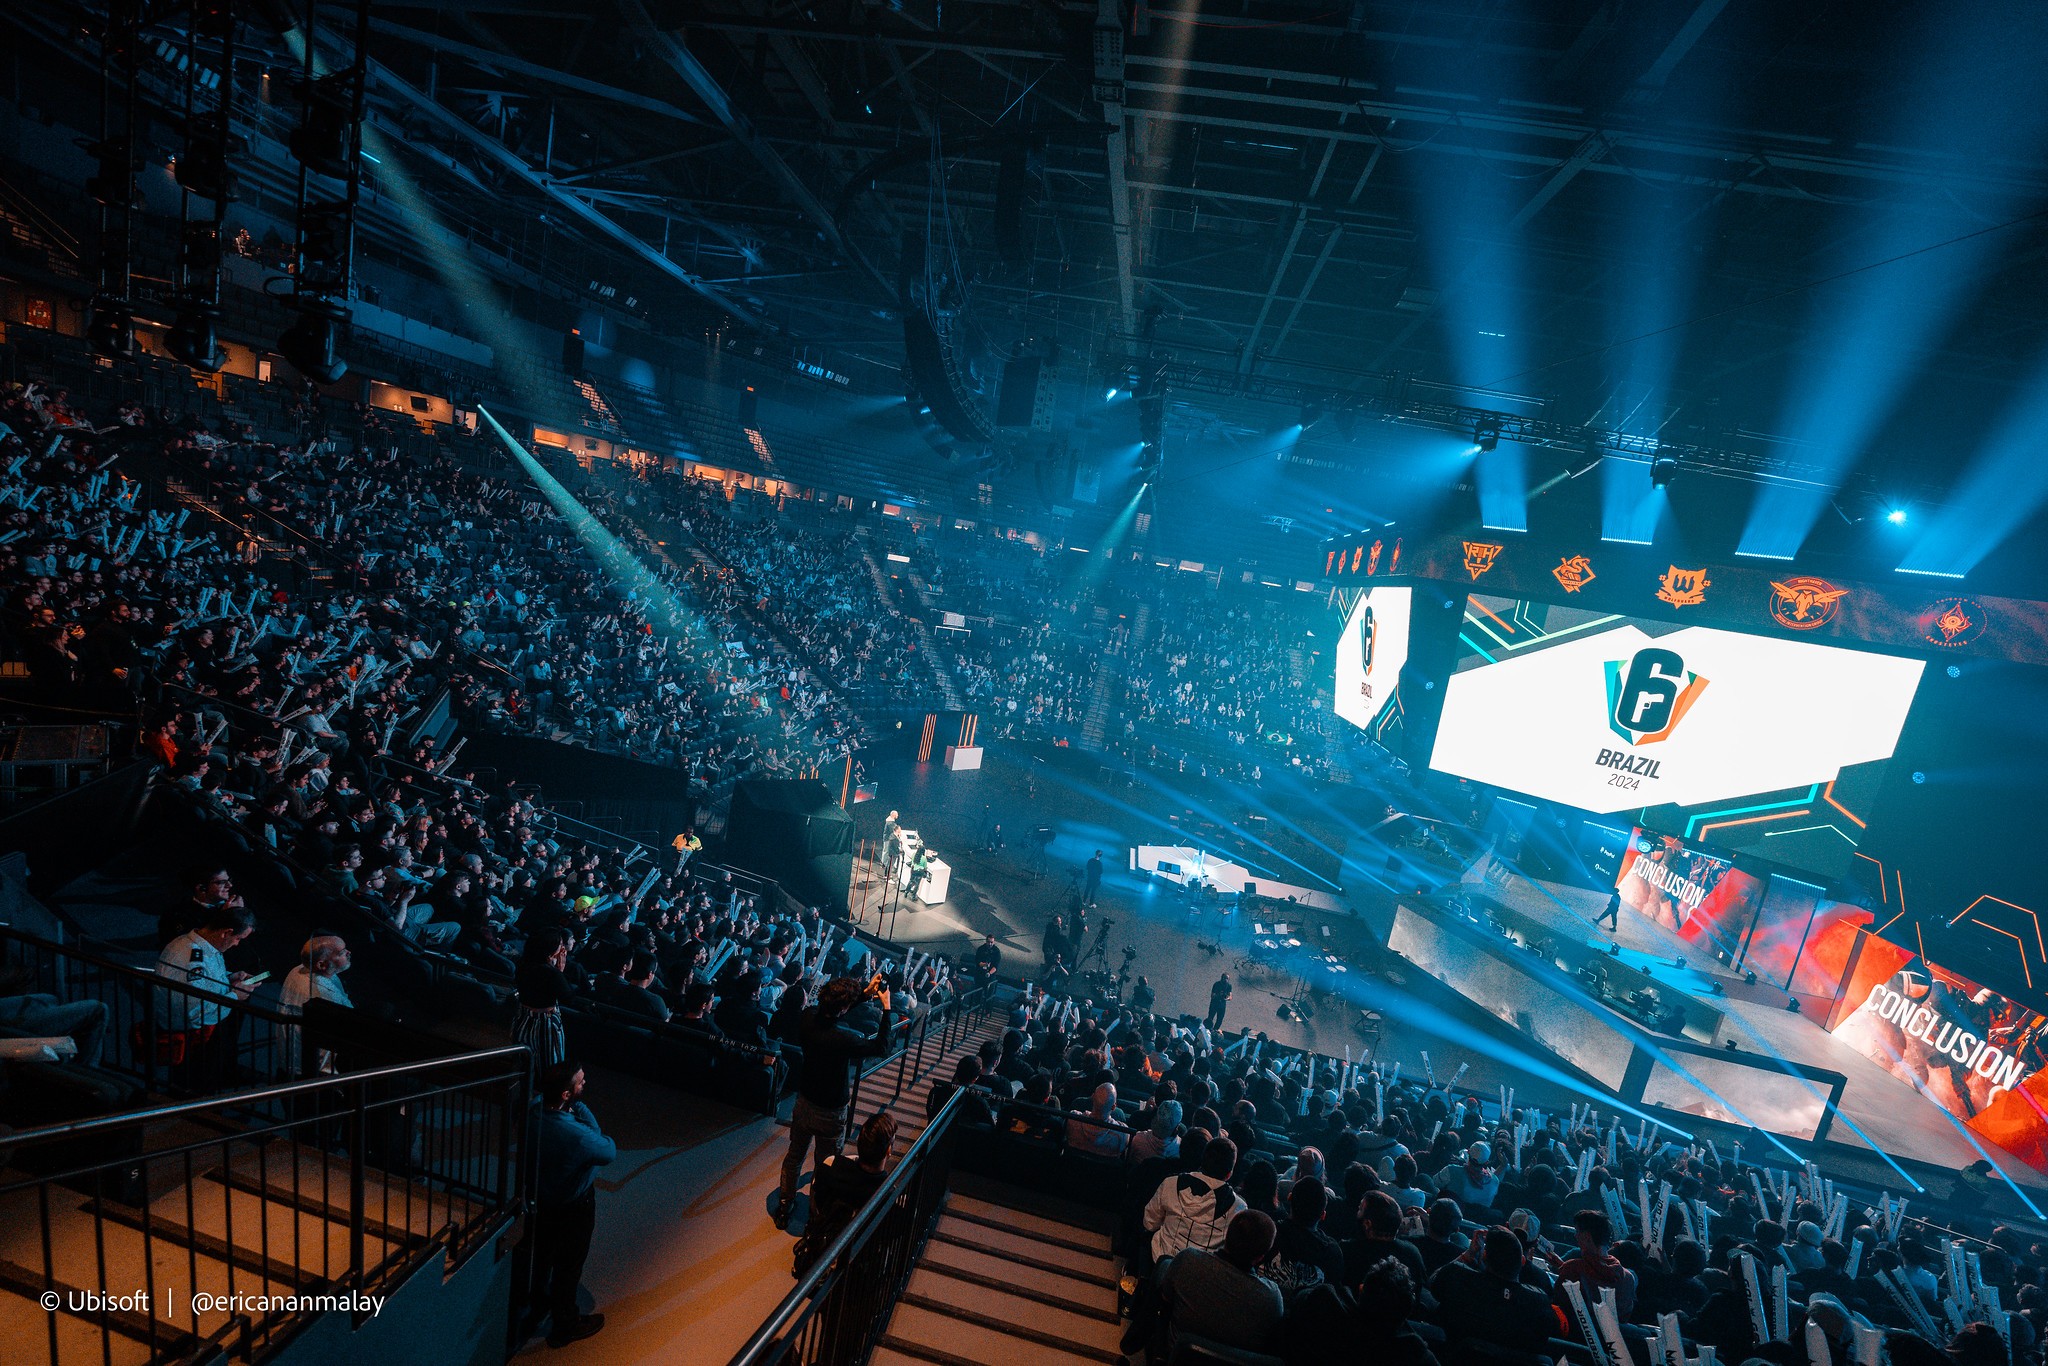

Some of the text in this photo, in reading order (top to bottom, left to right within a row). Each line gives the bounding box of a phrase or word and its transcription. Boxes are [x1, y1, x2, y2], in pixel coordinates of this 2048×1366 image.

[1595, 748, 1662, 781] BRAZIL
[1607, 772, 1641, 791] 2024
[1632, 854, 1706, 909] CONCLUSION
[1866, 984, 2025, 1092] CONCLUSION
